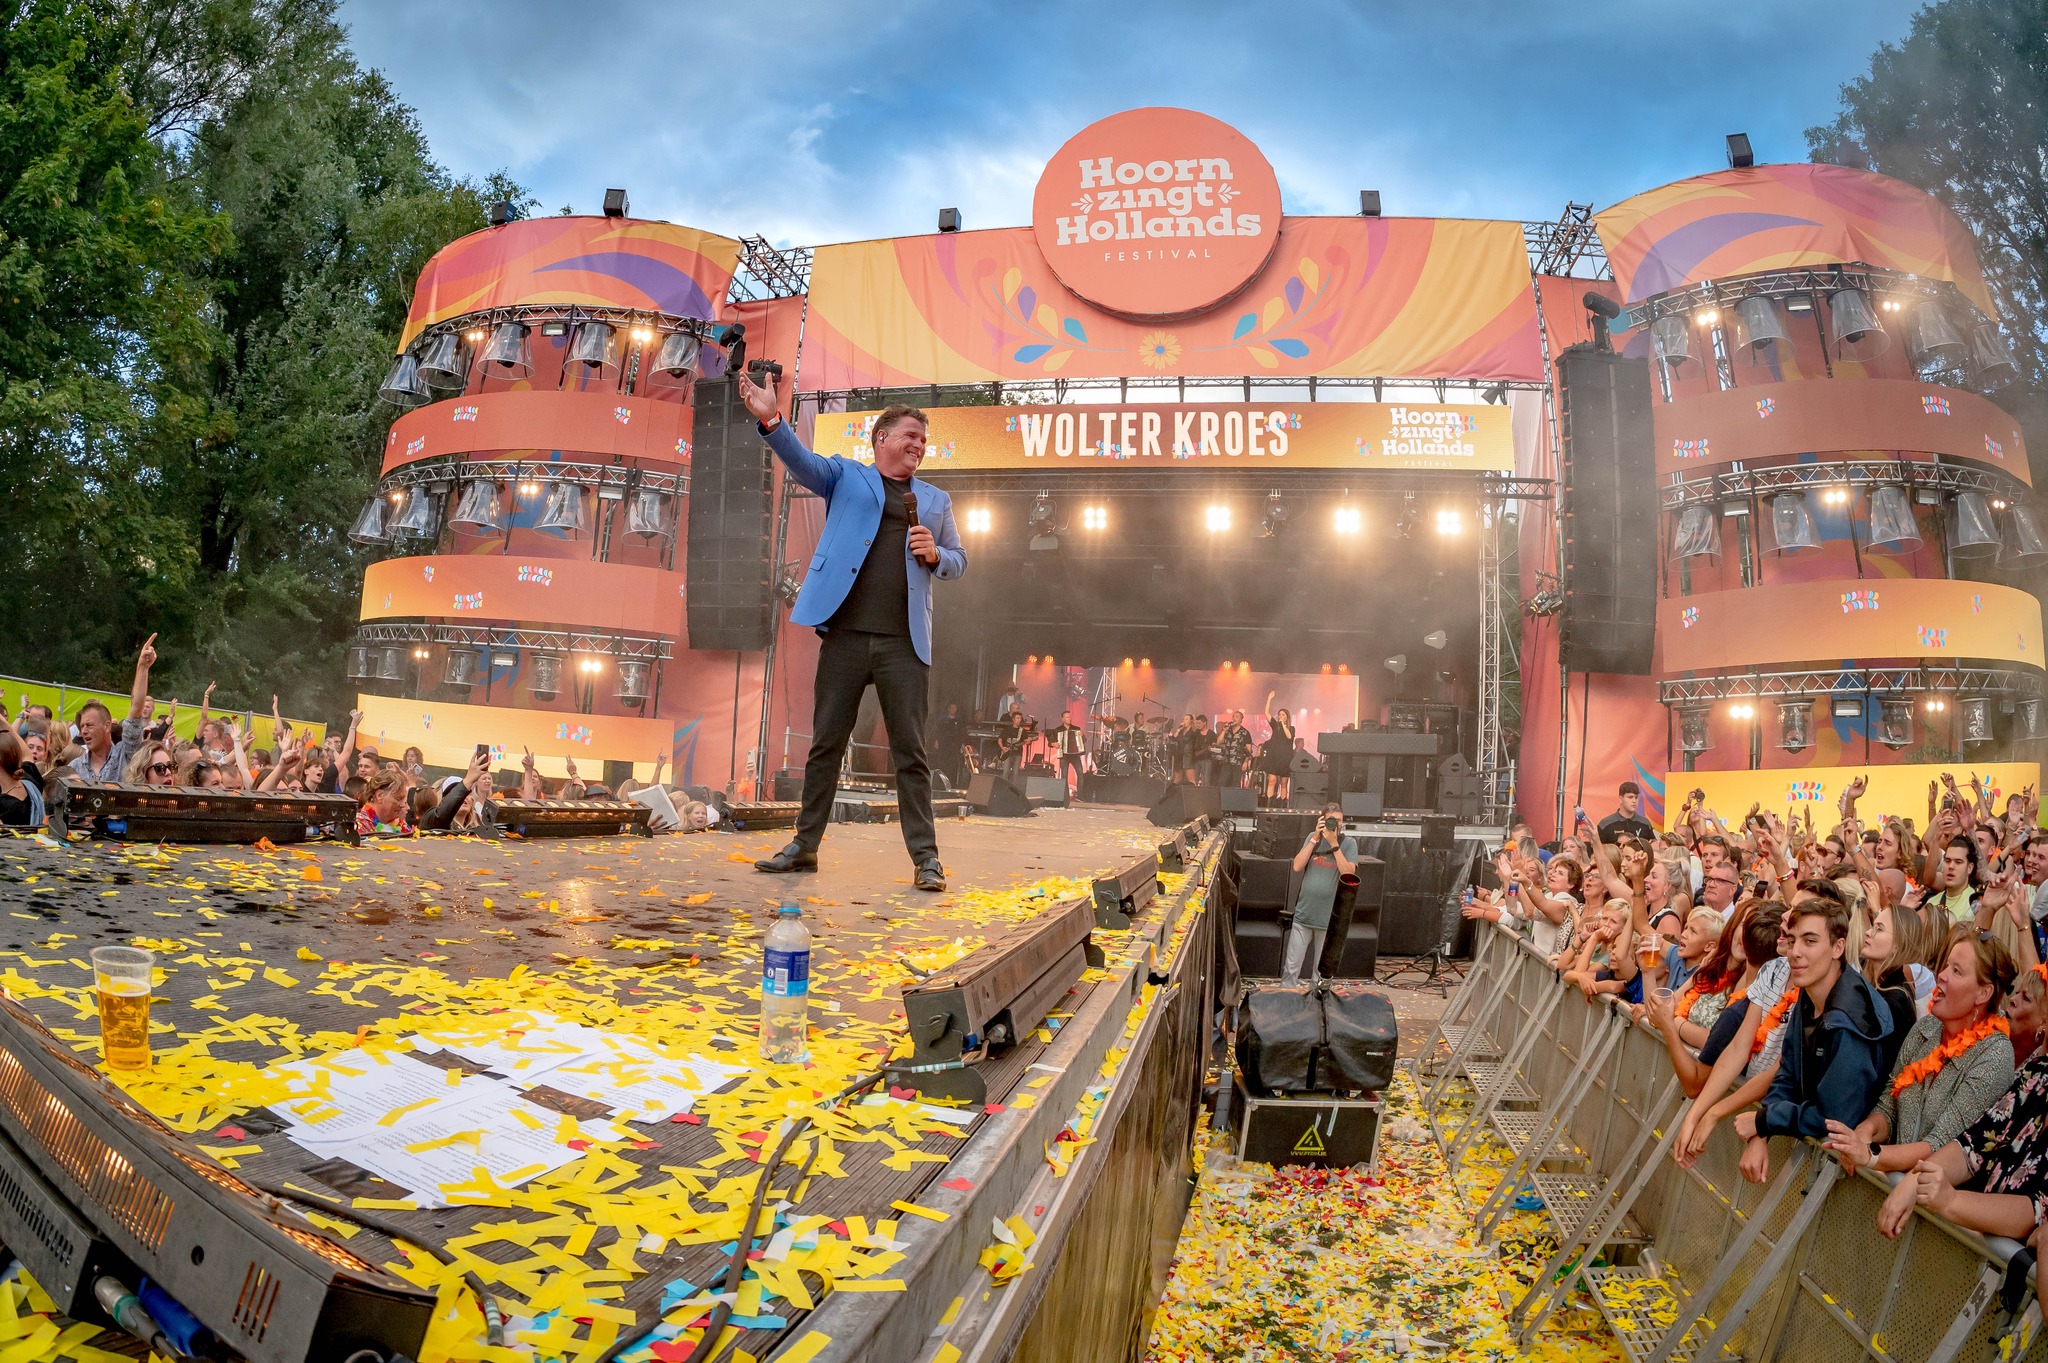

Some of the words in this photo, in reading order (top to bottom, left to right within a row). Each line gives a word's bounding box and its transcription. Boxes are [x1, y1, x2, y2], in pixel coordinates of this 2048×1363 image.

[1079, 157, 1234, 189] Hoorn
[1097, 182, 1214, 216] zingt
[1056, 208, 1262, 246] Hollands
[1104, 248, 1212, 263] FESTIVAL
[1390, 407, 1461, 424] Hoorn
[1019, 411, 1162, 457] WOLTER
[1174, 410, 1289, 457] KROES
[1400, 425, 1454, 443] zingt
[1382, 439, 1474, 456] Hollands
